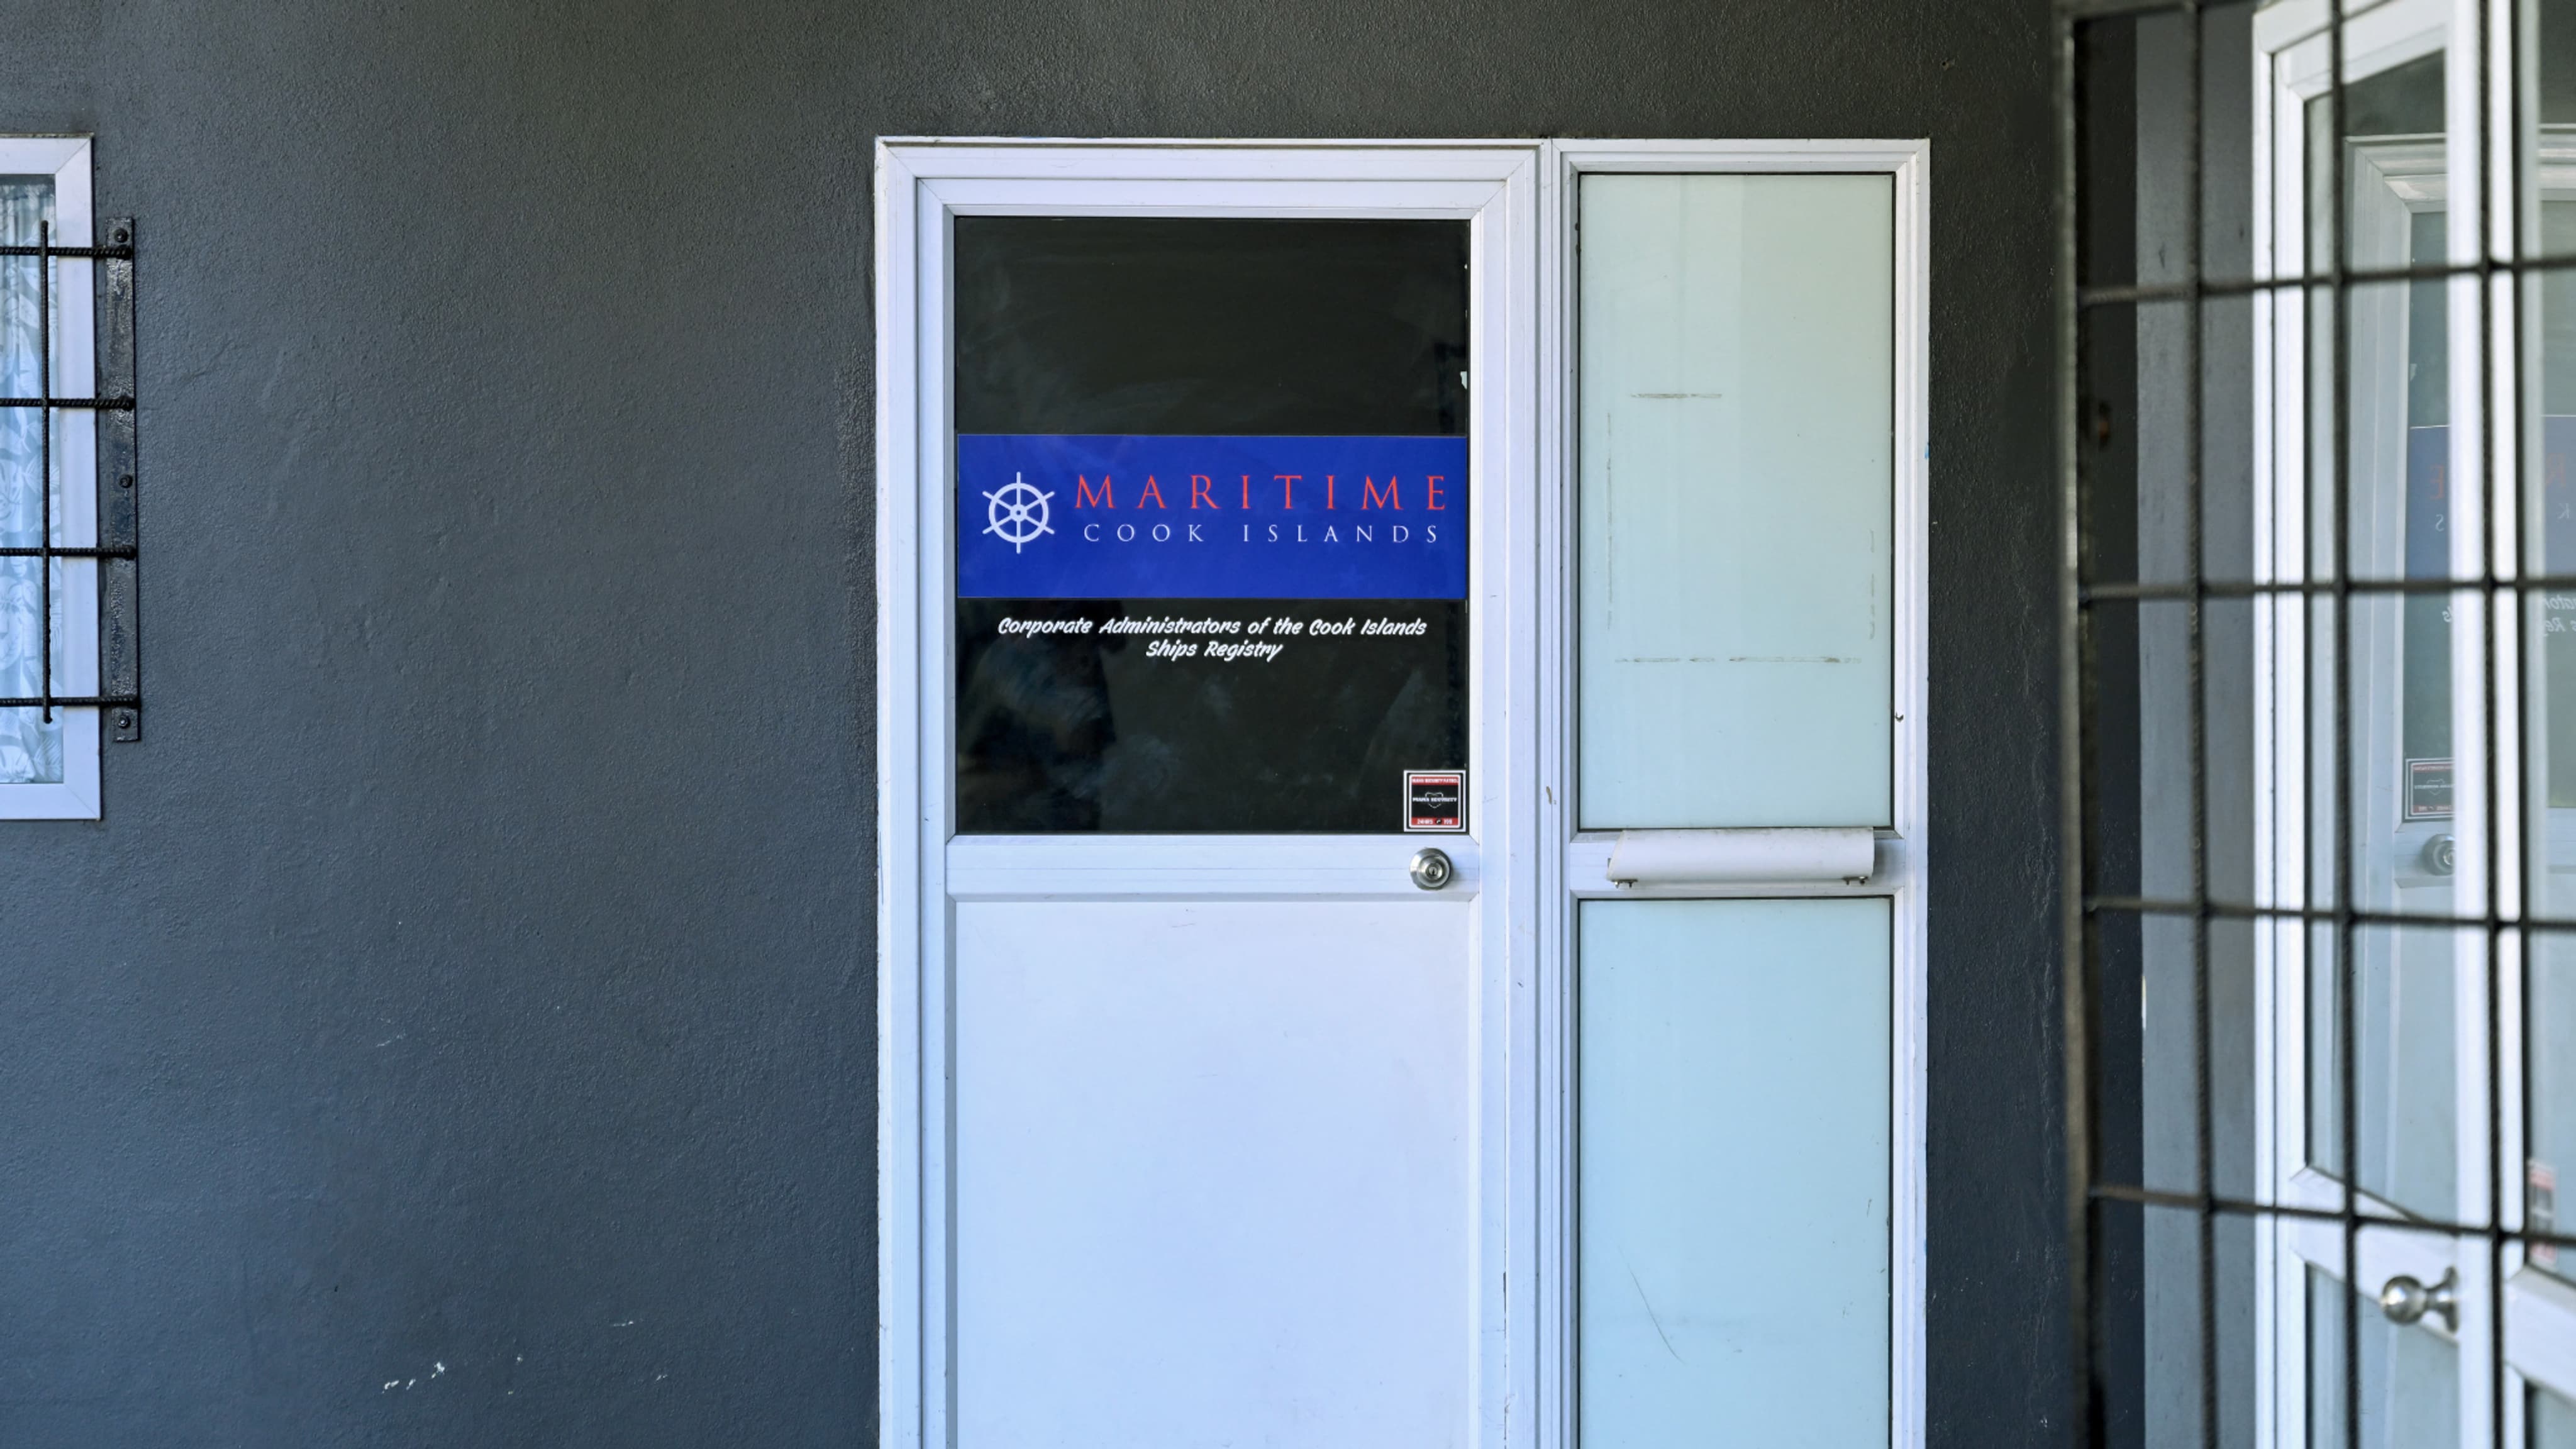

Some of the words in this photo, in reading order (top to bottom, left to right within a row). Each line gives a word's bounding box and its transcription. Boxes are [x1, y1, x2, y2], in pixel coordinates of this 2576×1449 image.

[1074, 474, 1446, 511] MARITIME
[1084, 523, 1204, 543] COOK
[1243, 524, 1438, 543] ISLANDS
[997, 617, 1094, 639] Corporate
[1097, 616, 1242, 634] Administrators
[1246, 616, 1272, 635] of
[1272, 616, 1304, 635] the
[1308, 617, 1357, 636] Cook
[1360, 617, 1428, 636] Islands
[1145, 638, 1199, 662] Ships
[1202, 639, 1284, 663] Registry
